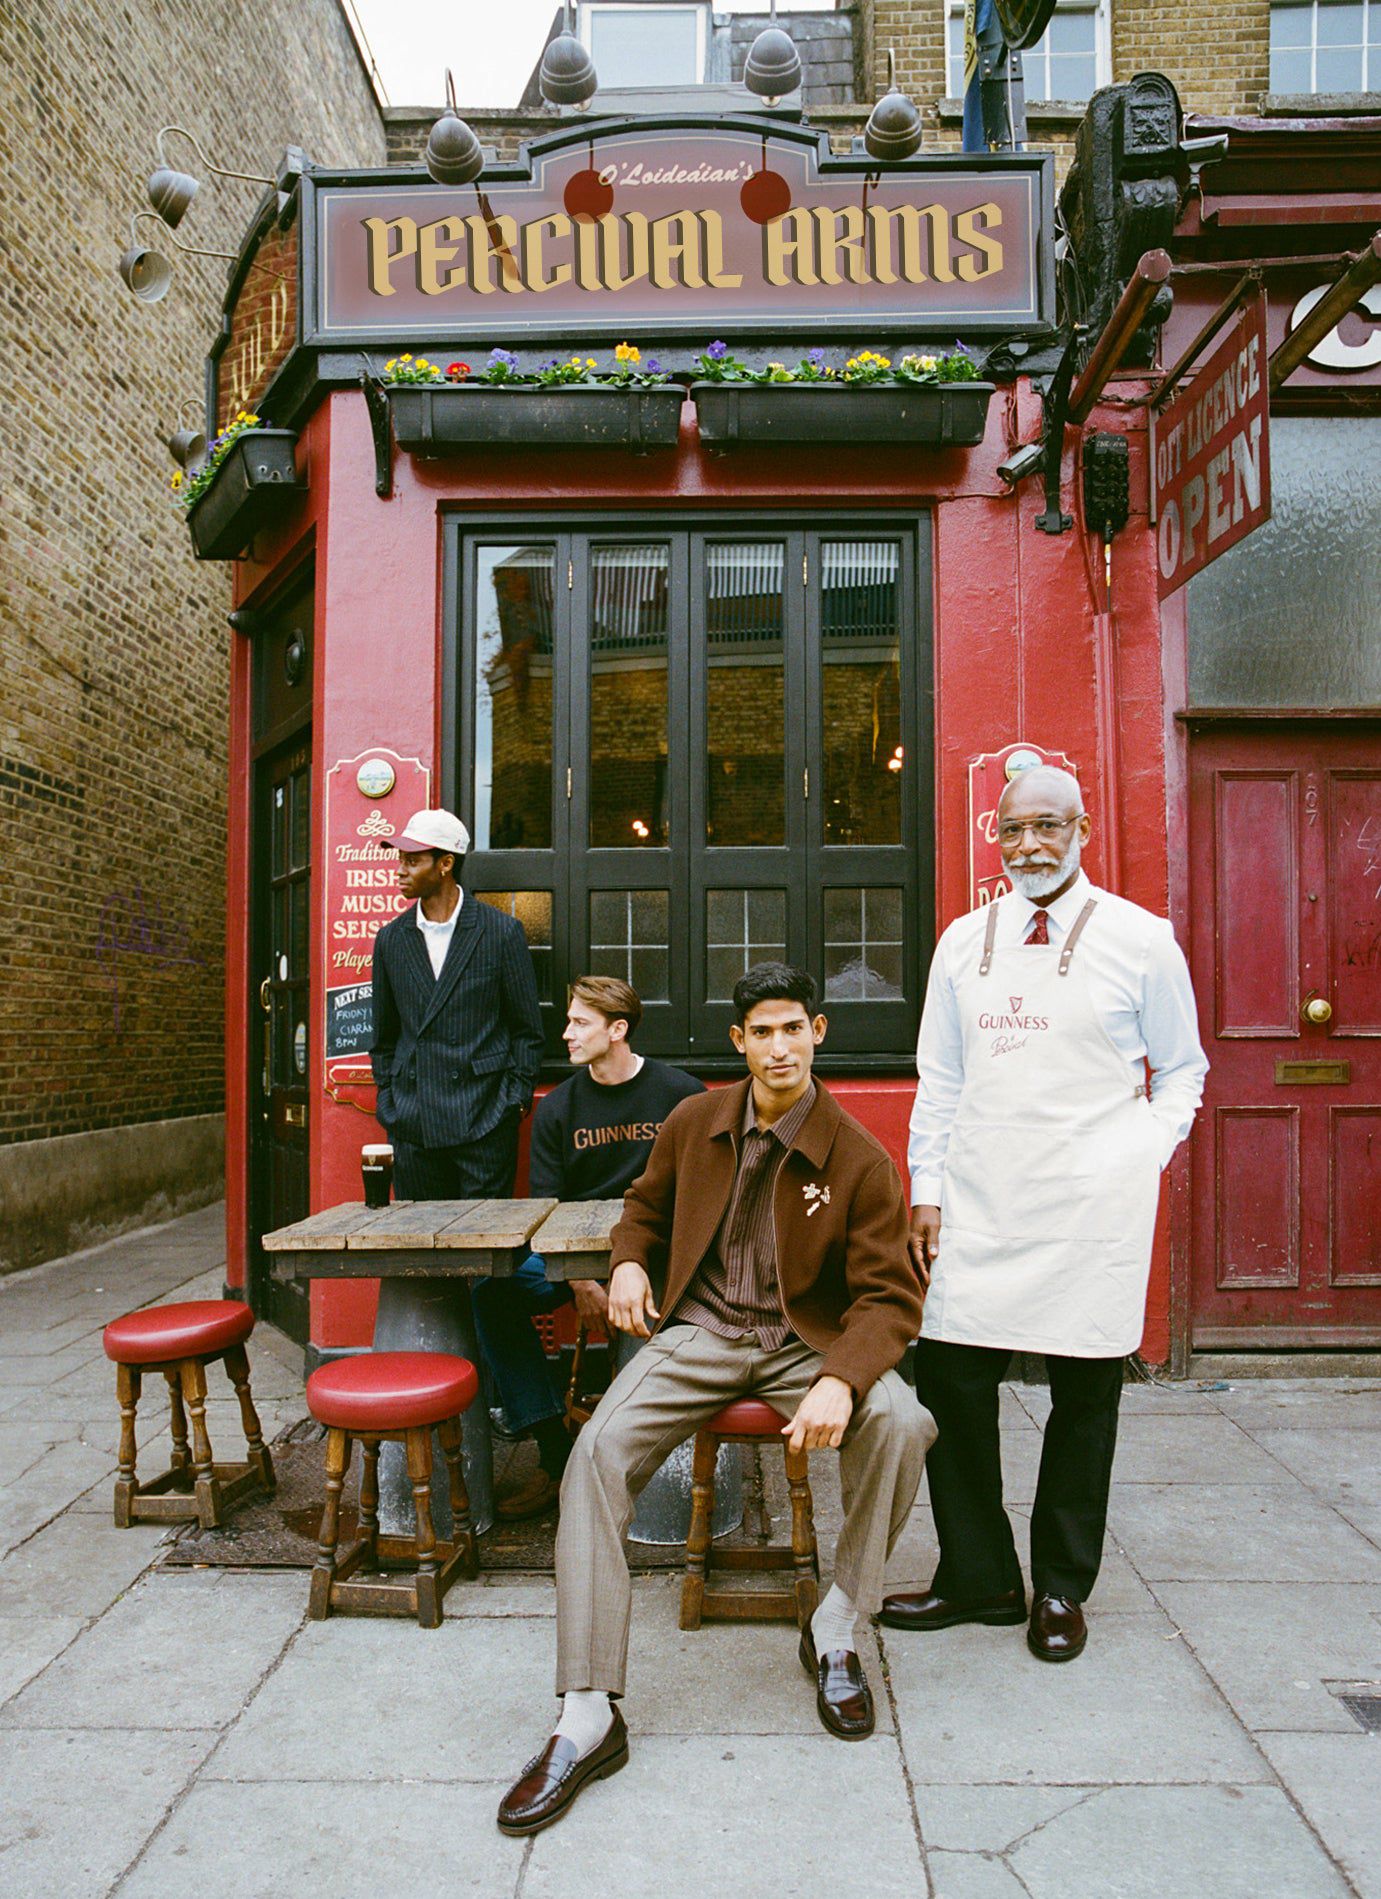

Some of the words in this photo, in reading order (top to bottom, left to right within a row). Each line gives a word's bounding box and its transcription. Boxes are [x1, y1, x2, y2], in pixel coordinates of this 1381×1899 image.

[360, 209, 743, 296] PERCIVAL
[761, 202, 1004, 287] ARMS
[1187, 333, 1260, 461] LICENCE
[1159, 413, 1262, 579] OPEN
[341, 894, 408, 913] MUSIC
[332, 917, 397, 939] SEIS
[334, 988, 358, 1011] NEXT
[336, 1008, 367, 1021] FRIDAY
[978, 1013, 1048, 1031] GUINNESS
